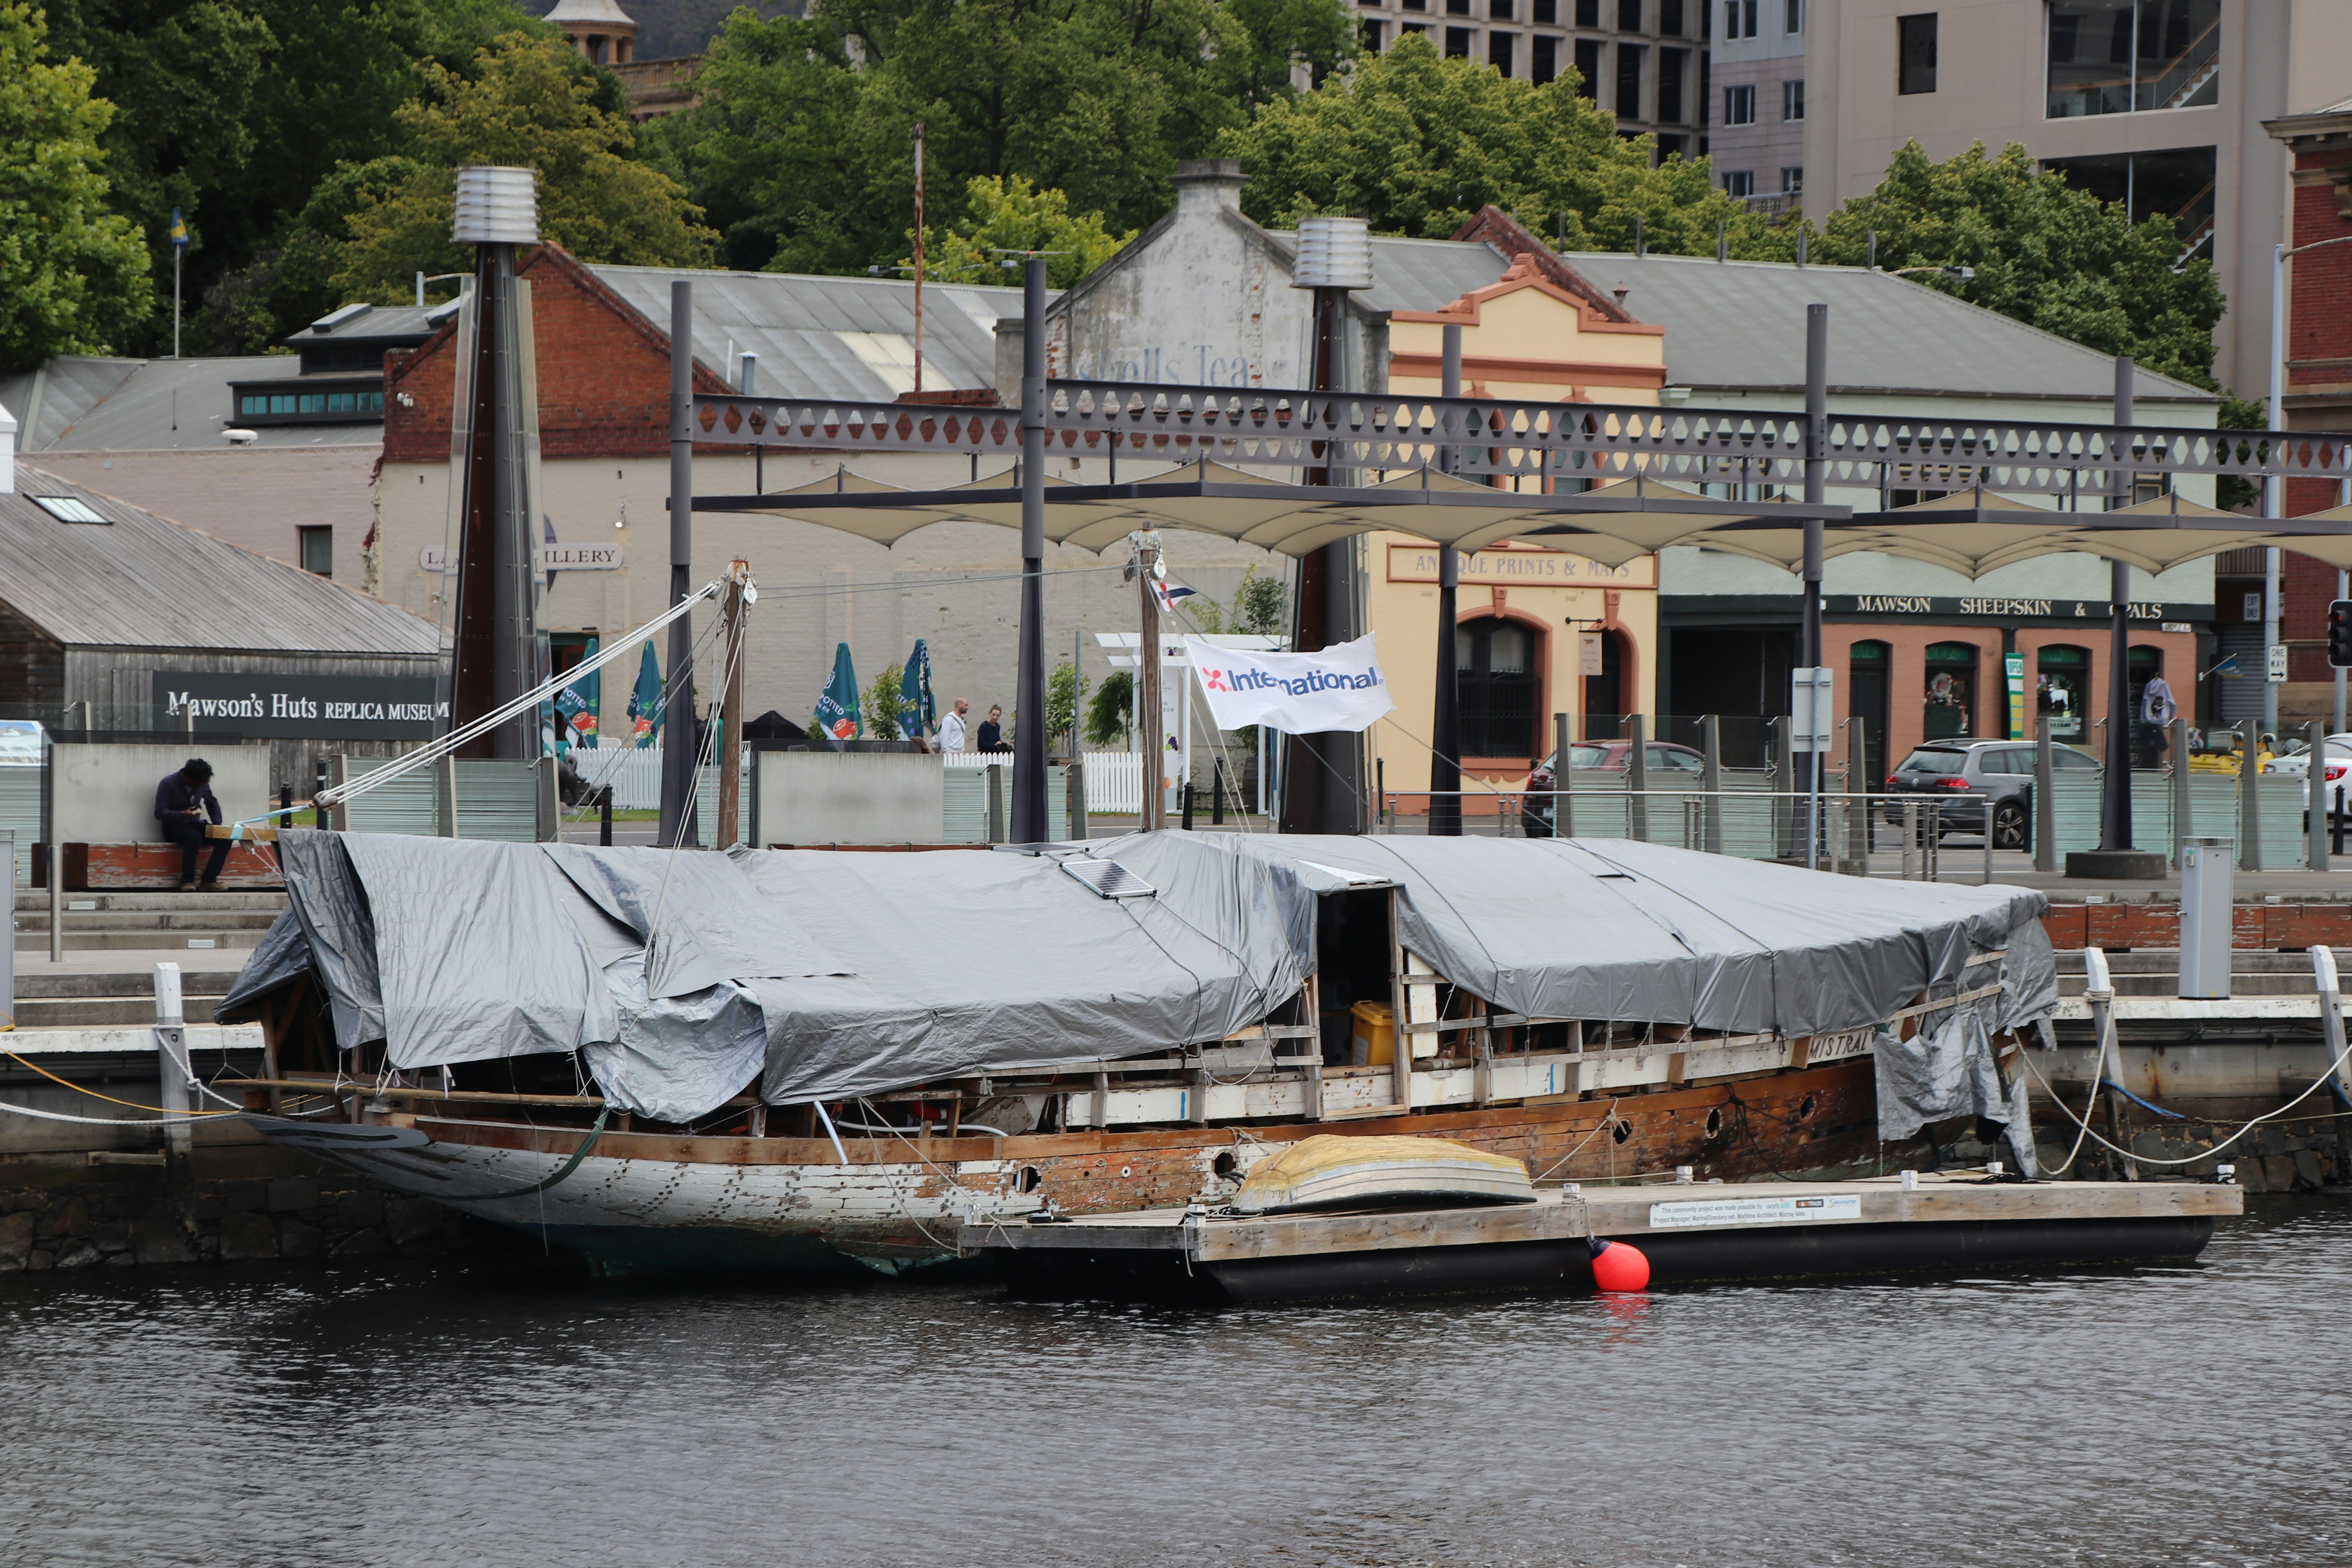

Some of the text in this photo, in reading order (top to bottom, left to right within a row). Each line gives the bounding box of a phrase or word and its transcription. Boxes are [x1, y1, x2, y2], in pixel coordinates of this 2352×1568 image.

[1194, 345, 1249, 388] Tea
[1415, 555, 1488, 575] ANQUE
[1497, 557, 1555, 575] PRINTS
[1564, 560, 1576, 575] &
[1856, 595, 1932, 613] MAWSON
[1959, 598, 2053, 616] SHEEPSKIN
[2074, 603, 2086, 617] &
[2271, 648, 2285, 657] ONE
[2008, 661, 2023, 673] OPEN
[2270, 660, 2285, 668] WAY
[167, 691, 450, 721] Mawson's Huts REPLICA MUSEUM
[1810, 1032, 1868, 1059] MISTRAL
